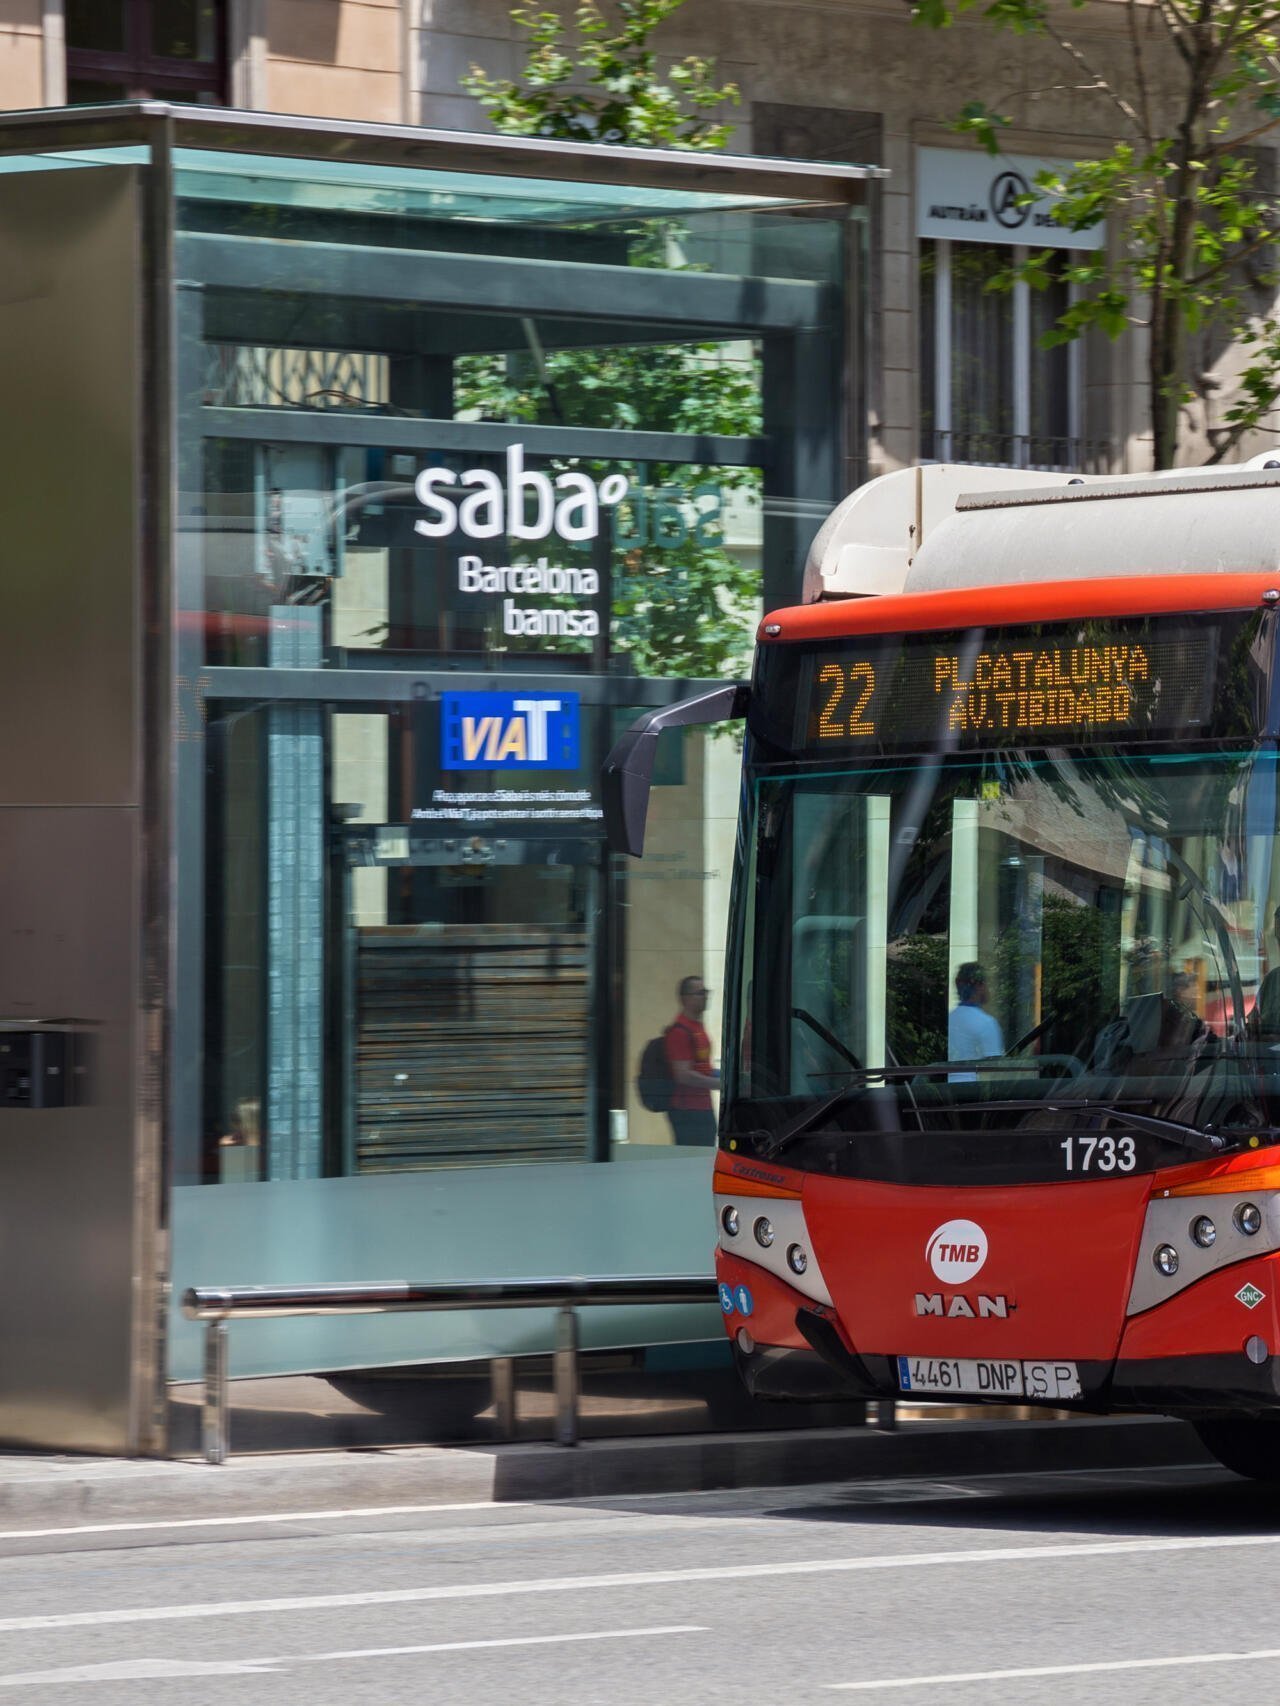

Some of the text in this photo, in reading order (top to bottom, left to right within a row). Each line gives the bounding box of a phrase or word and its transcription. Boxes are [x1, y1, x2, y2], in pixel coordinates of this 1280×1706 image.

[457, 555, 600, 595] Barcelona
[503, 598, 600, 637] bamsa
[818, 661, 876, 738] 22
[1060, 1136, 1137, 1172] 1733
[938, 1243, 980, 1263] TMB
[914, 1292, 1008, 1318] MAN
[1240, 1291, 1260, 1302] GNC
[914, 1360, 962, 1389] 4461
[976, 1362, 1018, 1391] DNP
